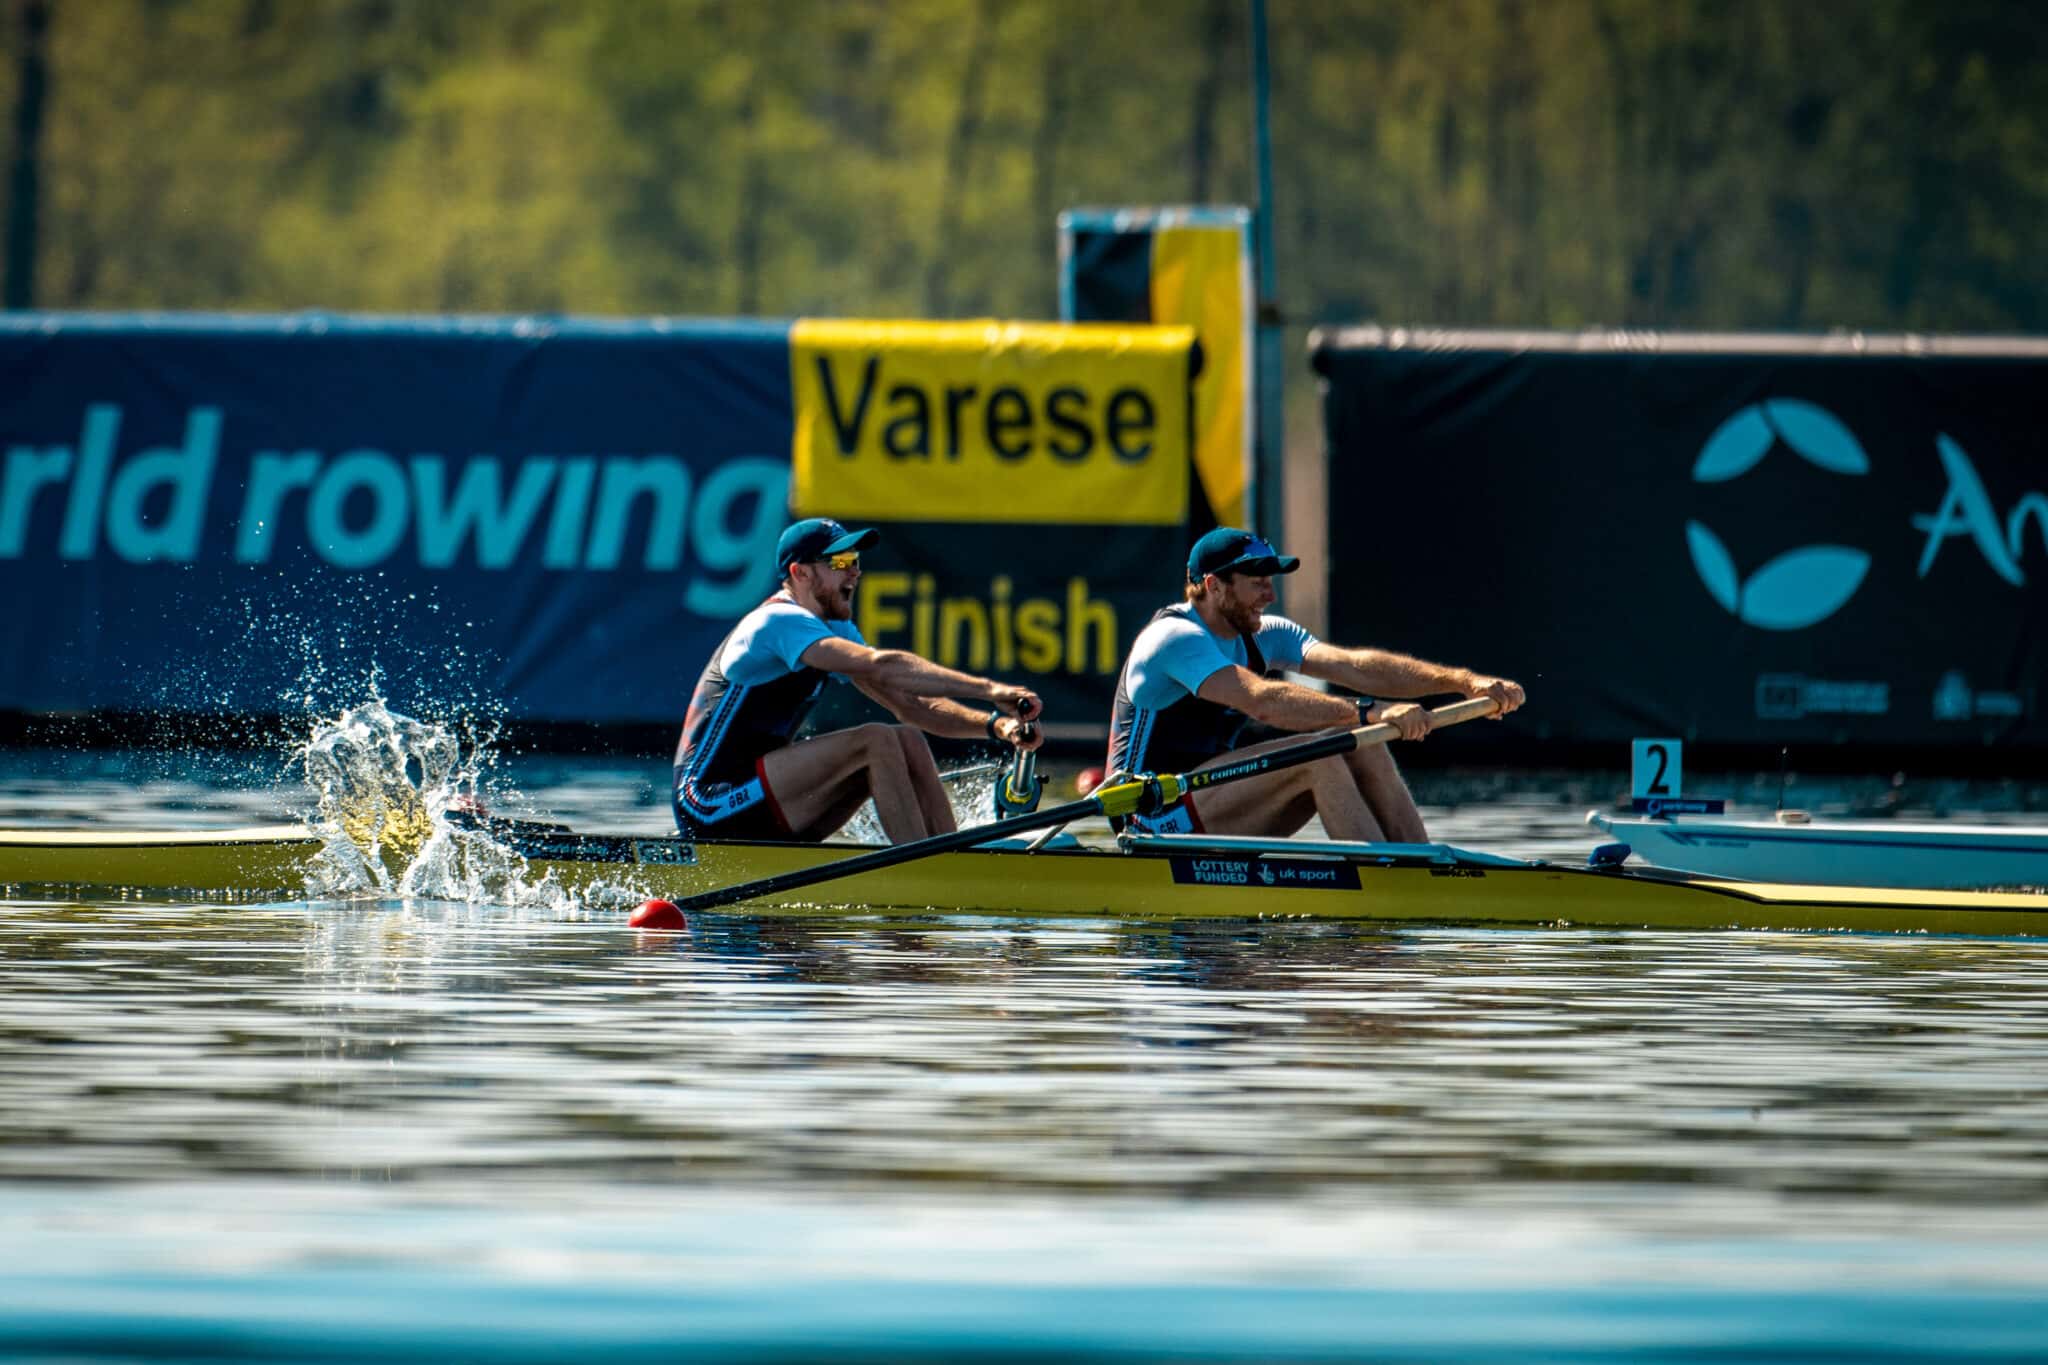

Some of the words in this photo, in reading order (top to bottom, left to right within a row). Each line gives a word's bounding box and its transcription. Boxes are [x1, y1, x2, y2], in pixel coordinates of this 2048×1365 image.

[814, 354, 1157, 465] Varese
[0, 403, 222, 561] rld
[233, 449, 796, 617] rowing
[859, 572, 1118, 675] Finish
[1646, 743, 1669, 795] 2
[1192, 860, 1249, 873] LOTTERY
[1195, 871, 1248, 883] FUNDED
[1279, 867, 1297, 879] uk
[1300, 869, 1336, 882] sport
